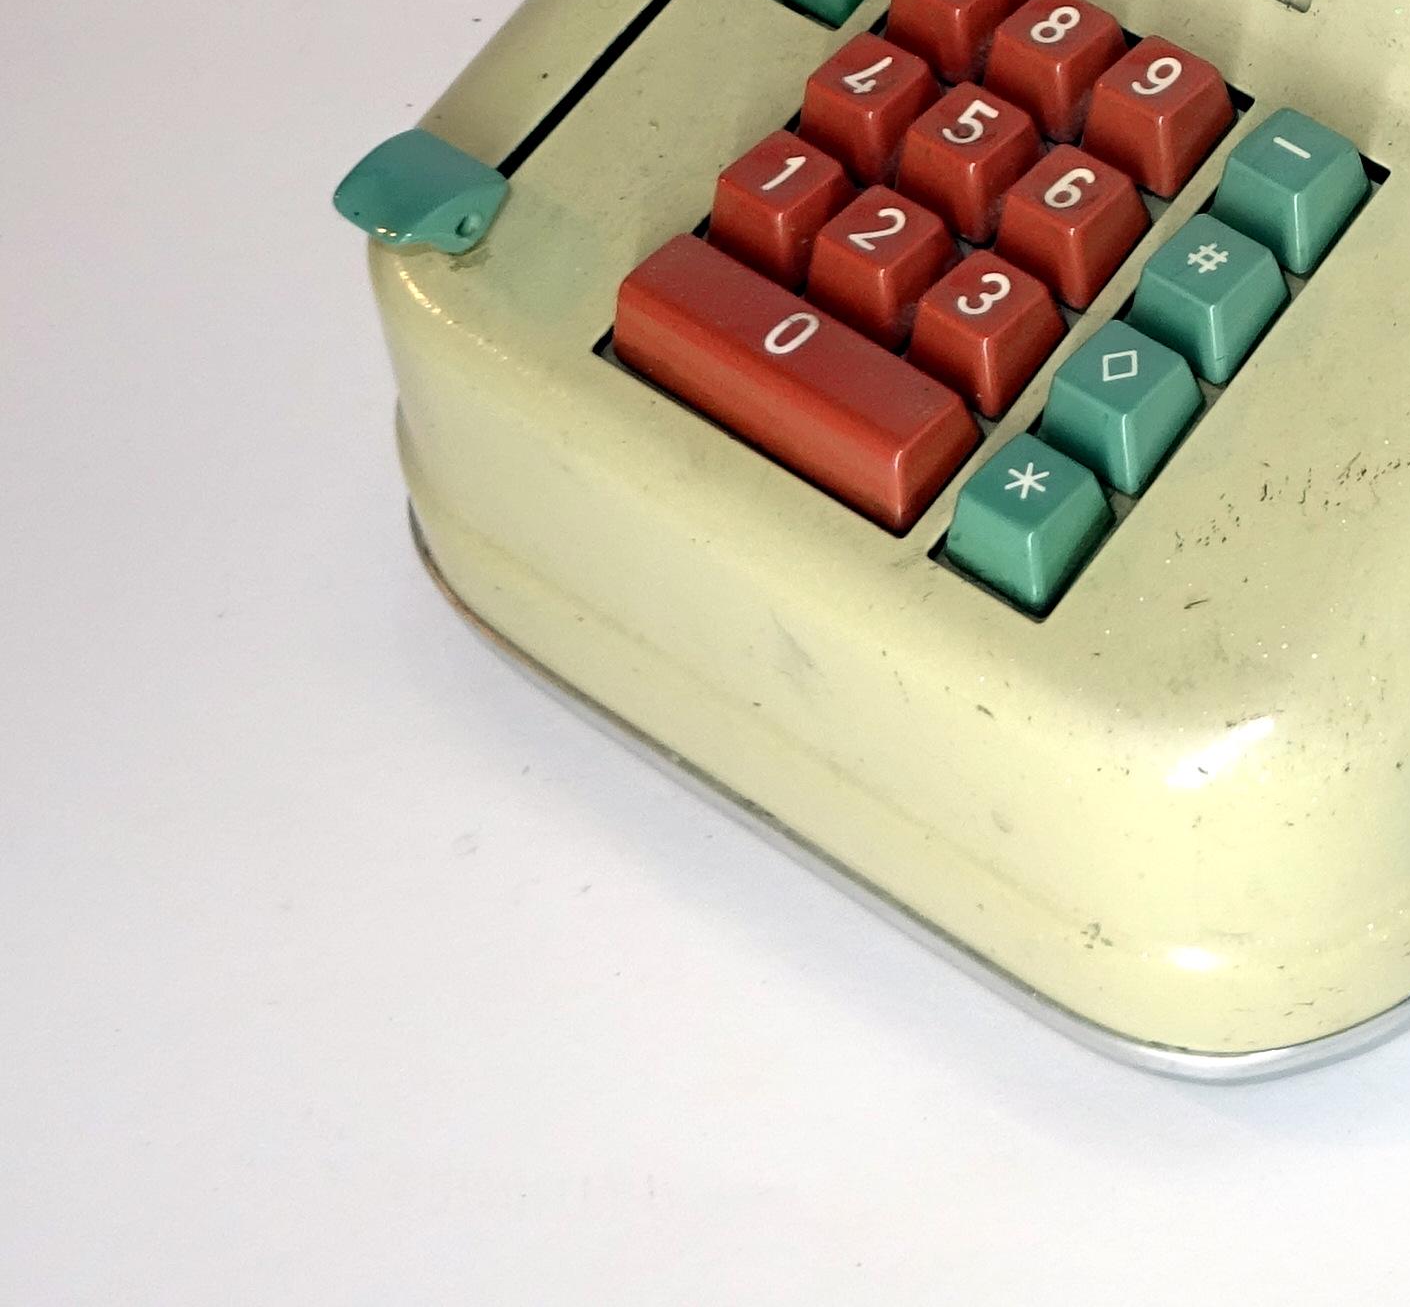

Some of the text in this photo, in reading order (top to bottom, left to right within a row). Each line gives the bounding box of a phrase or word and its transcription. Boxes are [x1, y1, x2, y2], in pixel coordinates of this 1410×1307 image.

[1031, 7, 1080, 43] 8
[843, 57, 892, 93] 4
[1132, 58, 1181, 94] 9
[943, 100, 998, 143] 5
[762, 157, 806, 190] 1
[1045, 168, 1095, 207] 6
[848, 208, 905, 250] 2
[958, 273, 1010, 314] 3
[764, 313, 819, 354] 0
